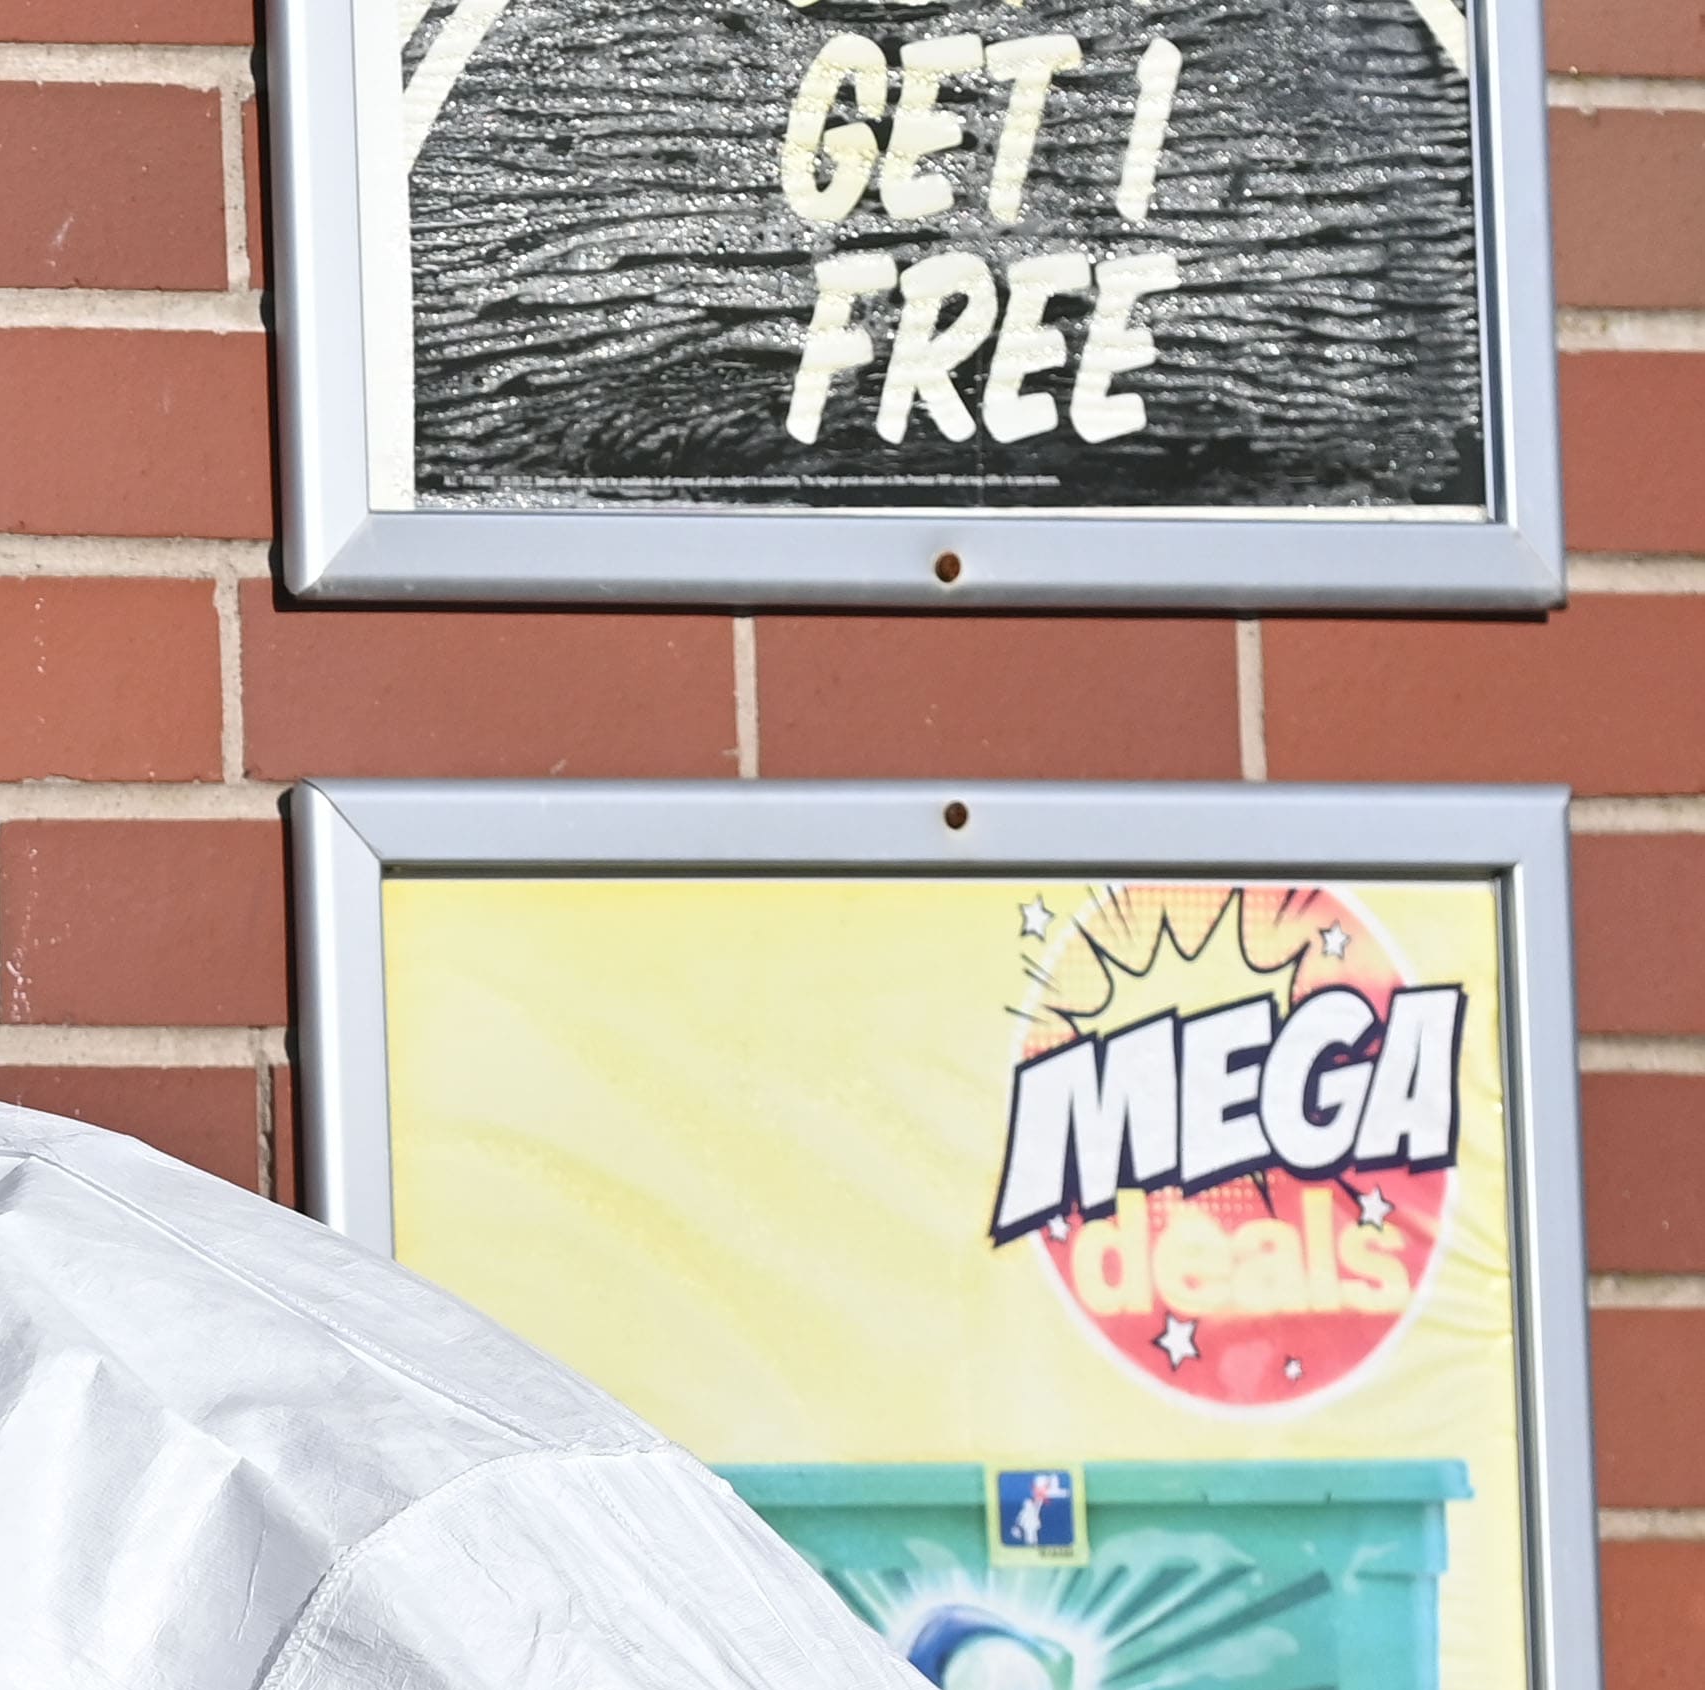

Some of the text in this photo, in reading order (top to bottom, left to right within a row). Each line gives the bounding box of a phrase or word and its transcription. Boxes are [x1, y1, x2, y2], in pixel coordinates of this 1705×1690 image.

[781, 32, 1083, 224] GET
[785, 251, 1183, 446] FREE
[992, 984, 1467, 1245] MEGA
[1070, 1188, 1411, 1315] deals
